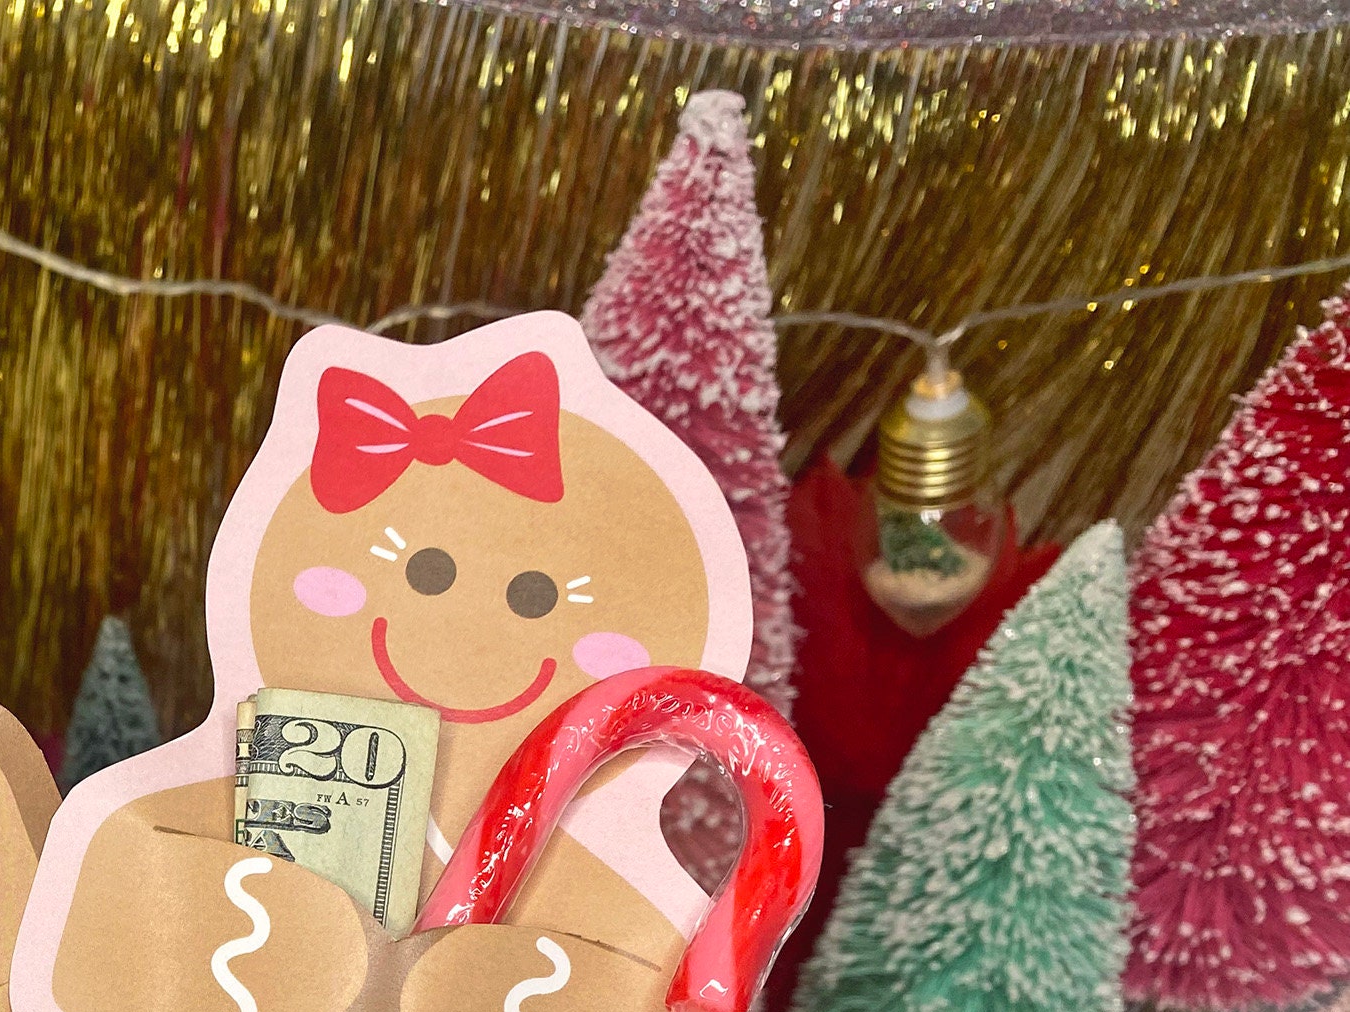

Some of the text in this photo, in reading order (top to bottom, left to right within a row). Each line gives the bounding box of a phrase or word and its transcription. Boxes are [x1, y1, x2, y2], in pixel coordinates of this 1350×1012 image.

[279, 718, 407, 789] 20
[335, 791, 351, 807] A
[356, 798, 370, 807] 57
